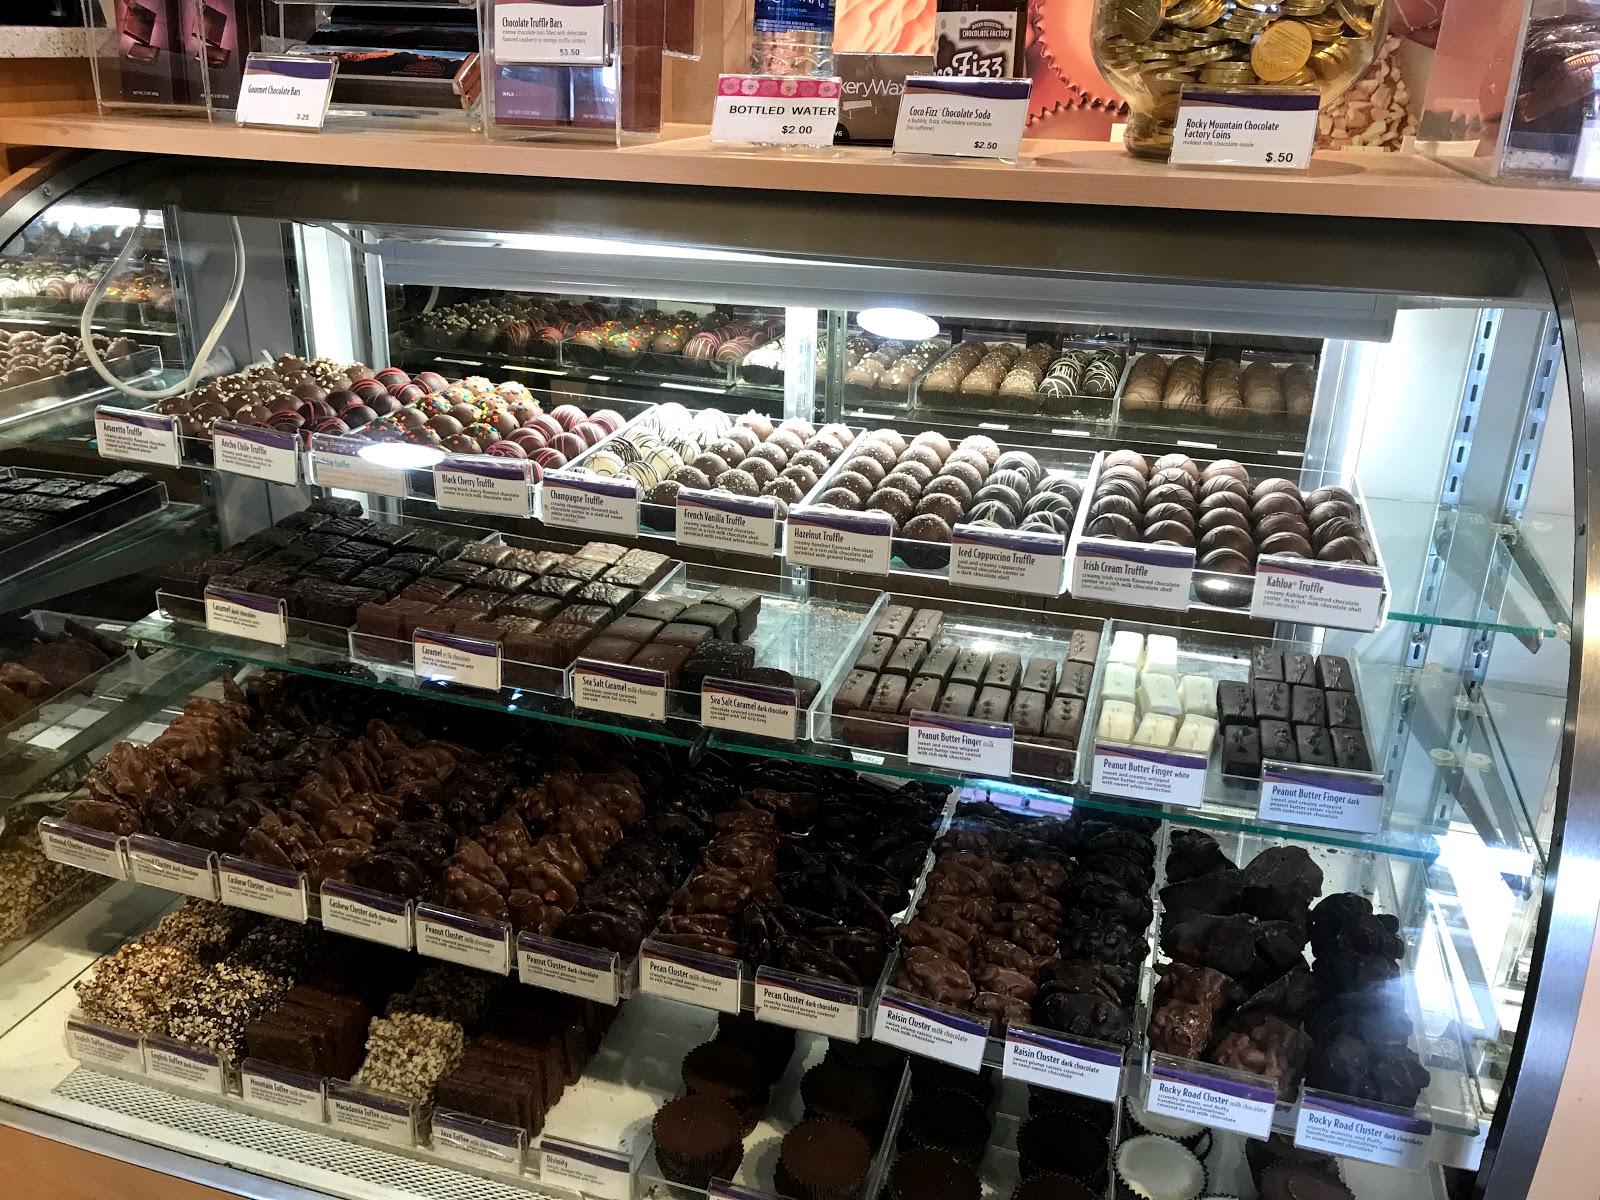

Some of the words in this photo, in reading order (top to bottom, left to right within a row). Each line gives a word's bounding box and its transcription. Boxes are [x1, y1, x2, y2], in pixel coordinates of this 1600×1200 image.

[502, 17, 529, 28] Chocolate
[530, 17, 549, 28] Truffle
[549, 18, 563, 29] Bars
[962, 29, 989, 38] CHOCOLATE
[989, 30, 1010, 38] FACTORY
[560, 48, 580, 56] $3.50
[951, 51, 1003, 77] Fizz
[248, 84, 268, 94] Gourmet
[268, 85, 290, 96] Chocolate
[290, 87, 301, 96] Bars
[729, 105, 785, 115] BOTTLED
[791, 106, 836, 116] WATER
[909, 105, 925, 117] Coco
[941, 107, 973, 119] Chocolate
[974, 108, 991, 119] Soda
[781, 125, 813, 135] $2.00
[1186, 118, 1208, 130] Rocky
[1208, 119, 1243, 130] Mountain
[1244, 120, 1280, 131] Chocolate
[1184, 128, 1211, 140] Factory
[1212, 129, 1231, 140] Coins
[974, 140, 998, 150] $2.50
[1265, 151, 1294, 163] $.50
[103, 422, 126, 435] Amaretto
[126, 426, 142, 437] Truffle
[221, 438, 237, 449] Ancho
[237, 441, 250, 452] Chile
[250, 443, 267, 455] Truffle
[441, 473, 456, 484] Black
[457, 476, 476, 488] Cherry
[476, 477, 495, 489] Truffle
[550, 489, 583, 503] Champagne
[584, 494, 604, 506] Truffle
[684, 509, 703, 520] French
[704, 511, 724, 523] Vanilla
[726, 514, 746, 526] Truffle
[794, 527, 822, 540] Hazelnut
[823, 531, 844, 543] Truffle
[958, 546, 972, 558] Iced
[973, 548, 1011, 563] Cappuccino
[1012, 552, 1036, 565] Truffle
[1083, 559, 1100, 571] Irish
[1100, 561, 1123, 574] Cream
[1124, 564, 1149, 577] Truffle
[1298, 580, 1324, 594] Truffle
[212, 602, 231, 613] Caramel
[1320, 602, 1347, 611] chocolate
[1348, 605, 1362, 613] shell
[422, 645, 443, 658] Caramel
[582, 676, 593, 686] Sea
[593, 677, 604, 688] Salt
[604, 679, 627, 692] Caramel
[627, 686, 638, 694] milk
[638, 687, 658, 697] chocolate
[710, 694, 720, 704] Sea
[721, 696, 733, 707] Salt
[733, 698, 757, 711] Caramel
[757, 704, 767, 713] dark
[767, 707, 789, 716] chocolate
[917, 729, 940, 741] Peanut
[940, 732, 961, 744] Butter
[962, 734, 982, 747] Finger
[1103, 758, 1127, 771] Peanut
[1128, 761, 1151, 774] Butter
[1151, 764, 1173, 778] Finger
[1174, 770, 1190, 779] white
[1272, 785, 1297, 798] Peanut
[1298, 788, 1322, 801] Butter
[1323, 791, 1346, 805] Finger
[1347, 797, 1360, 806] dark
[227, 875, 246, 886] Cashew
[247, 879, 265, 891] Cluster
[329, 898, 350, 911] Cashew
[349, 904, 368, 916] Cluster
[424, 924, 444, 936] Peanut
[444, 929, 464, 941] Cluster
[526, 954, 546, 967] Peanut
[546, 959, 567, 971] Cluster
[567, 966, 577, 974] dark
[578, 969, 599, 979] chocolate
[649, 961, 667, 973] Pecan
[667, 965, 689, 978] Cluster
[689, 973, 700, 982] milk
[700, 976, 722, 987] chocolate
[764, 988, 782, 1000] Pecan
[783, 992, 804, 1005] Cluster
[805, 999, 817, 1008] dark
[817, 1002, 840, 1013] chocolate
[887, 1009, 907, 1024] Raisin
[908, 1016, 931, 1031] Cluster
[931, 1027, 943, 1036] milk
[943, 1030, 968, 1043] chocolate
[1013, 1045, 1035, 1058] Raisin
[1036, 1050, 1060, 1064] Cluster
[1061, 1058, 1074, 1068] dark
[1074, 1062, 1100, 1074] chocolate
[1159, 1083, 1182, 1096] Rocky
[1182, 1087, 1201, 1100] Road
[1203, 1092, 1229, 1106] Cluster
[1229, 1100, 1241, 1109] milk
[1242, 1103, 1267, 1114] chocolate
[1308, 1112, 1332, 1128] Rocky
[1333, 1118, 1354, 1131] Road
[1355, 1123, 1383, 1137] Cluster
[1384, 1132, 1396, 1141] dark
[1397, 1135, 1423, 1147] chocolate
[546, 1154, 568, 1168] Divinity
